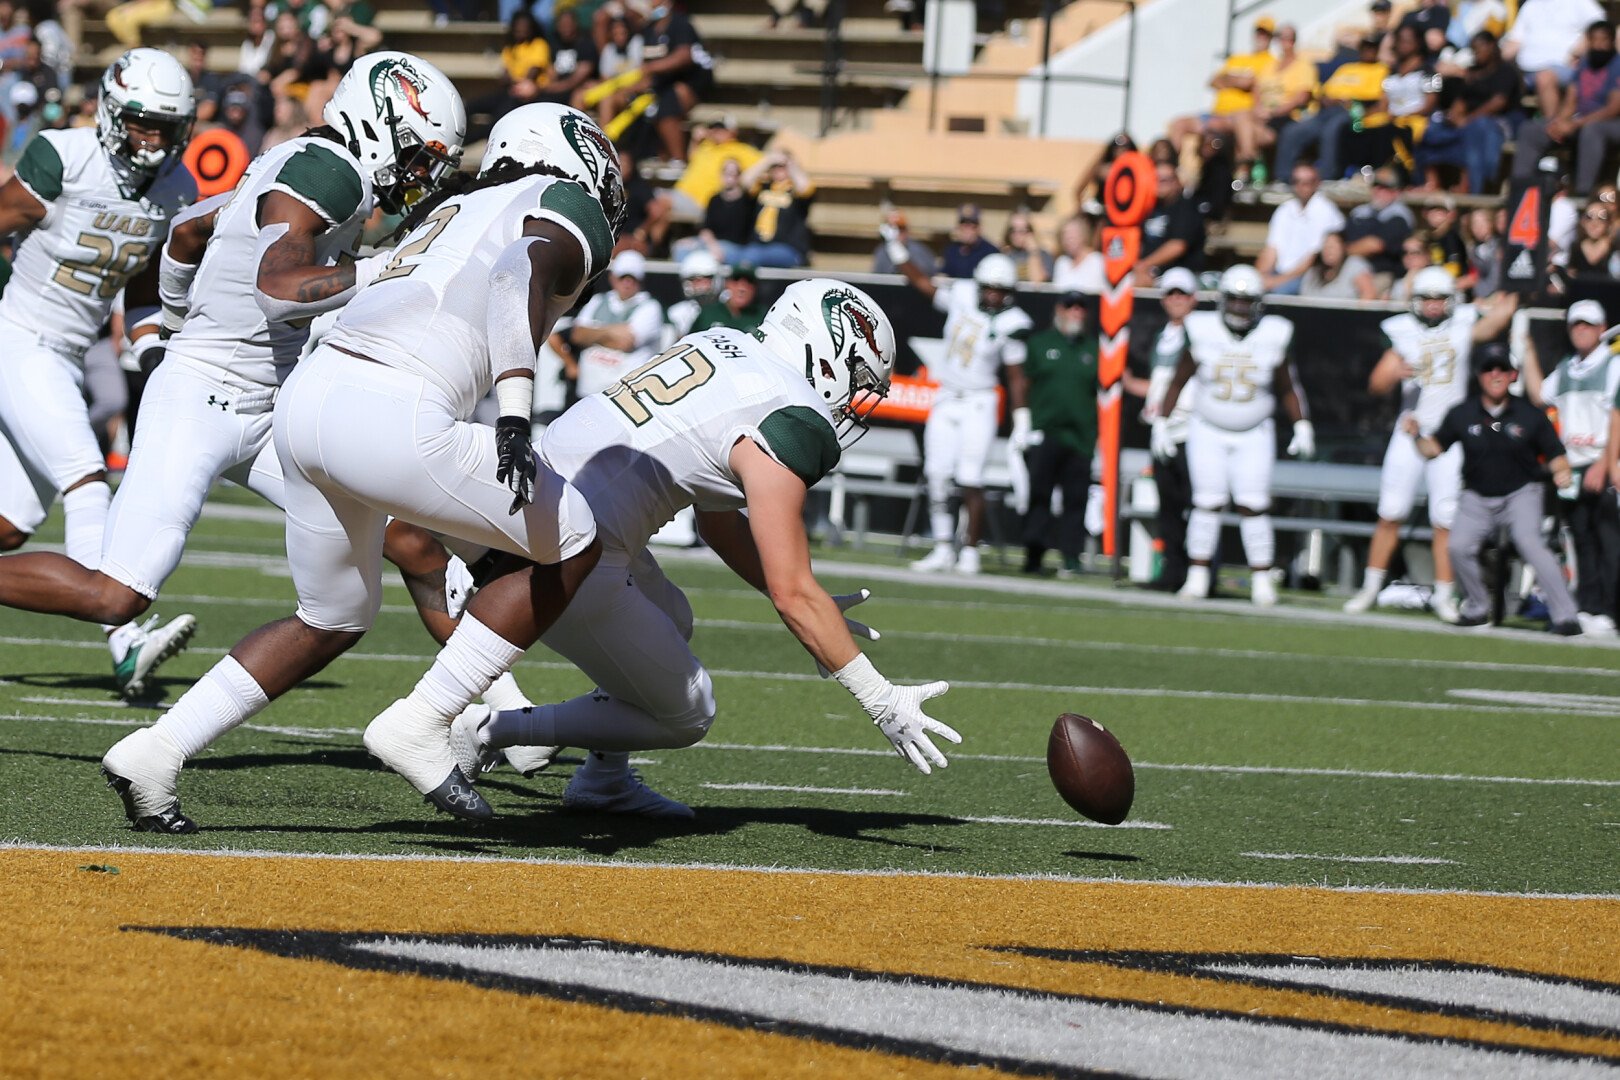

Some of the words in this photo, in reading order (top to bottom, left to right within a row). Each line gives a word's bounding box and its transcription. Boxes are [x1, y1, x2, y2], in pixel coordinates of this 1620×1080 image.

[93, 211, 151, 236] UAB
[1508, 186, 1540, 249] 4
[702, 333, 748, 359] CASH
[602, 343, 716, 428] 12
[1212, 363, 1259, 403] 55
